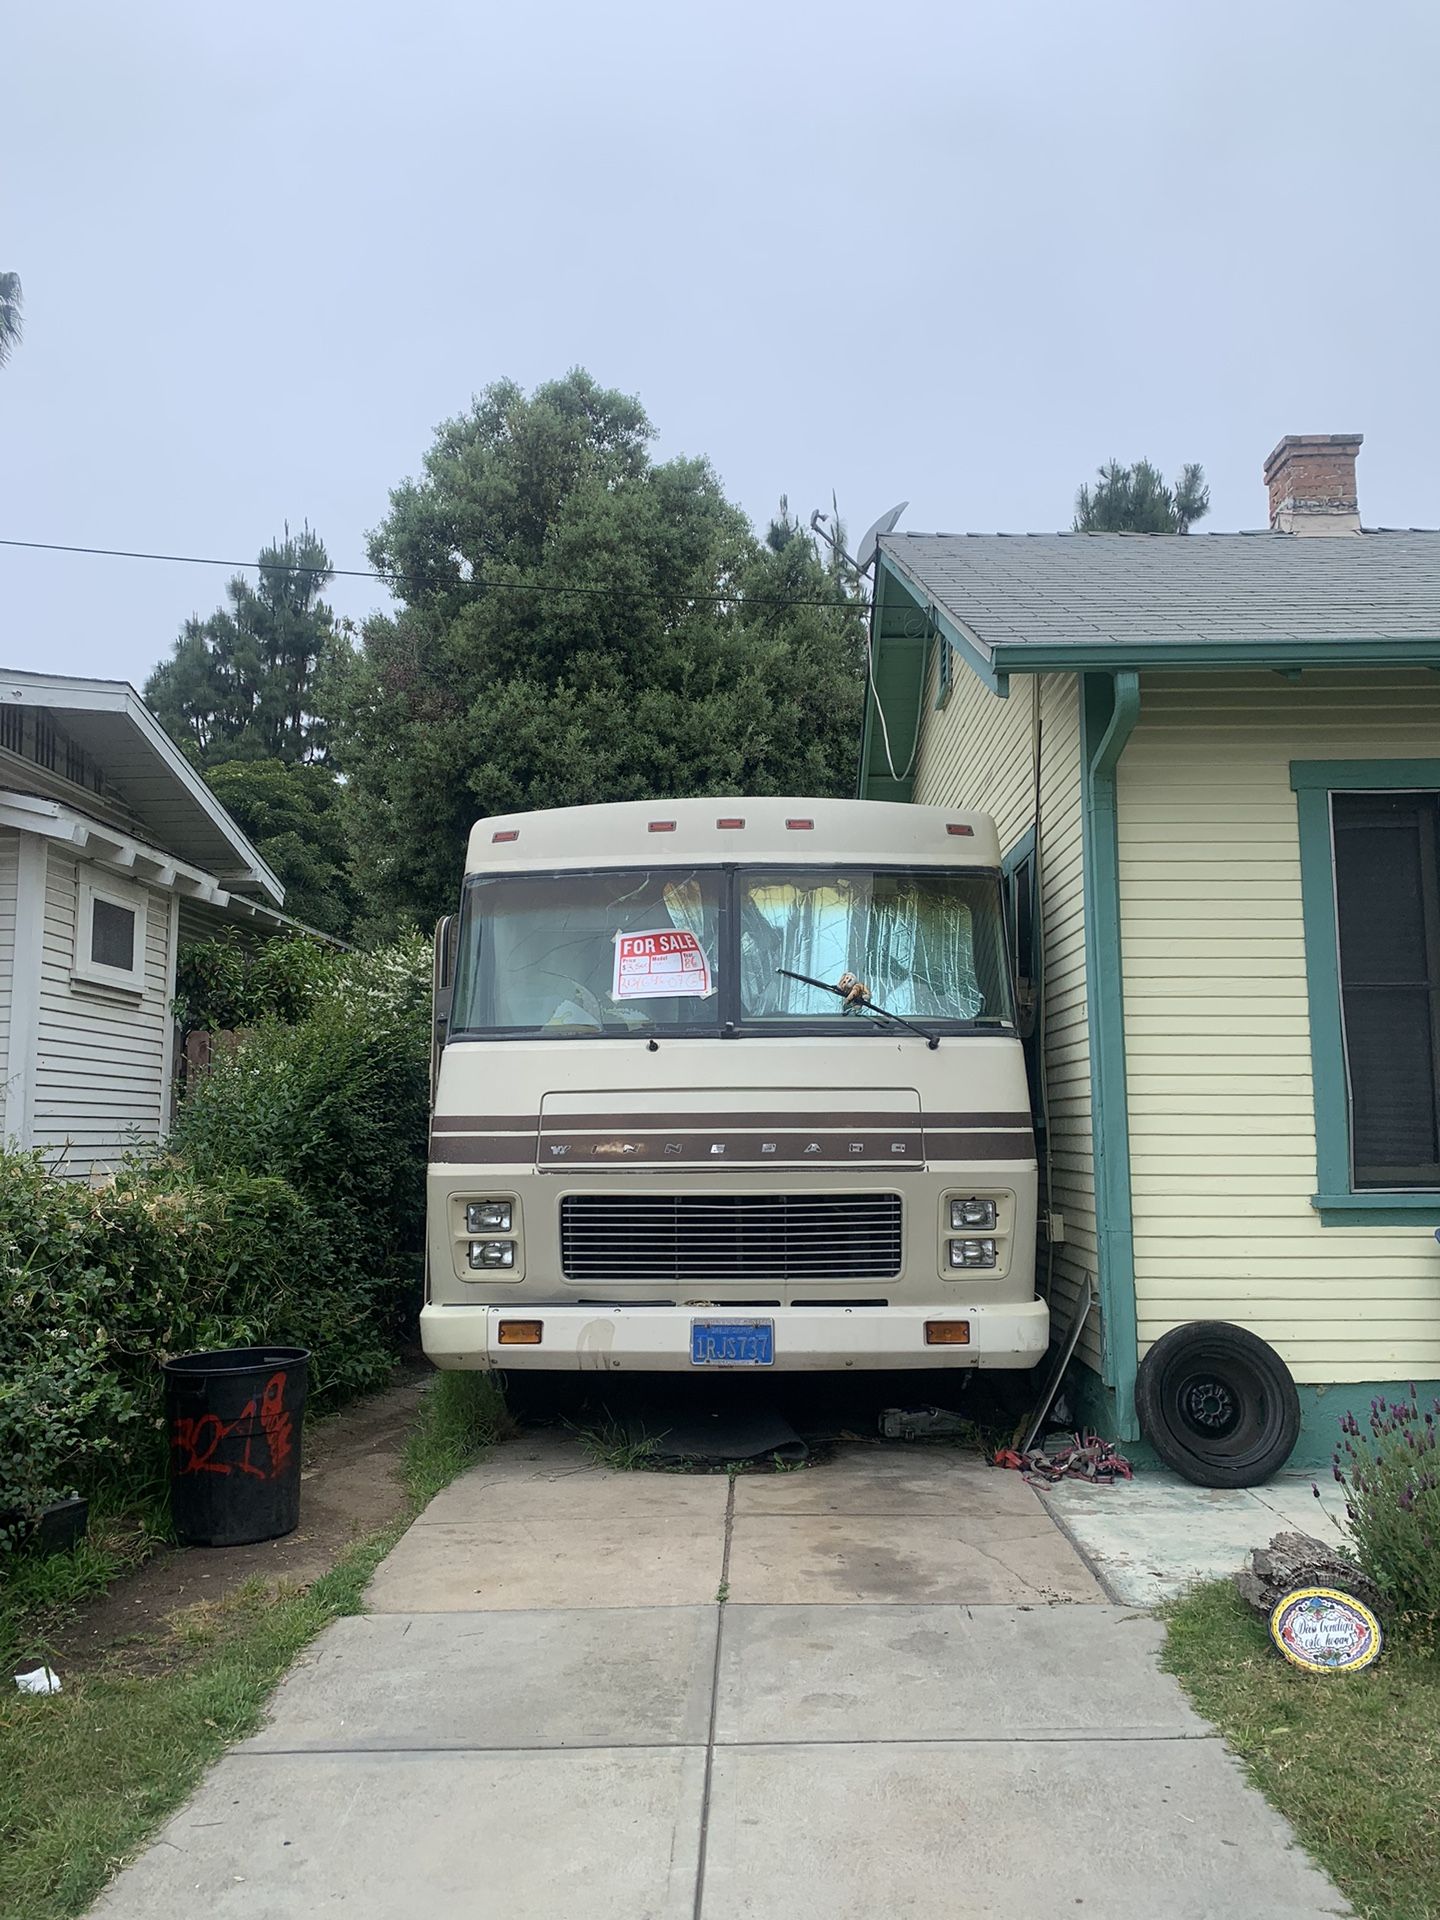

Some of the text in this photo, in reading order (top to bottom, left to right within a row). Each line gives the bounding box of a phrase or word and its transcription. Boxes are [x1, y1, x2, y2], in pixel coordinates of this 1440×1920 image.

[623, 934, 696, 955] FOR SALE
[549, 1142, 906, 1154] WINNEBAGO
[696, 1336, 768, 1359] 1RJS737
